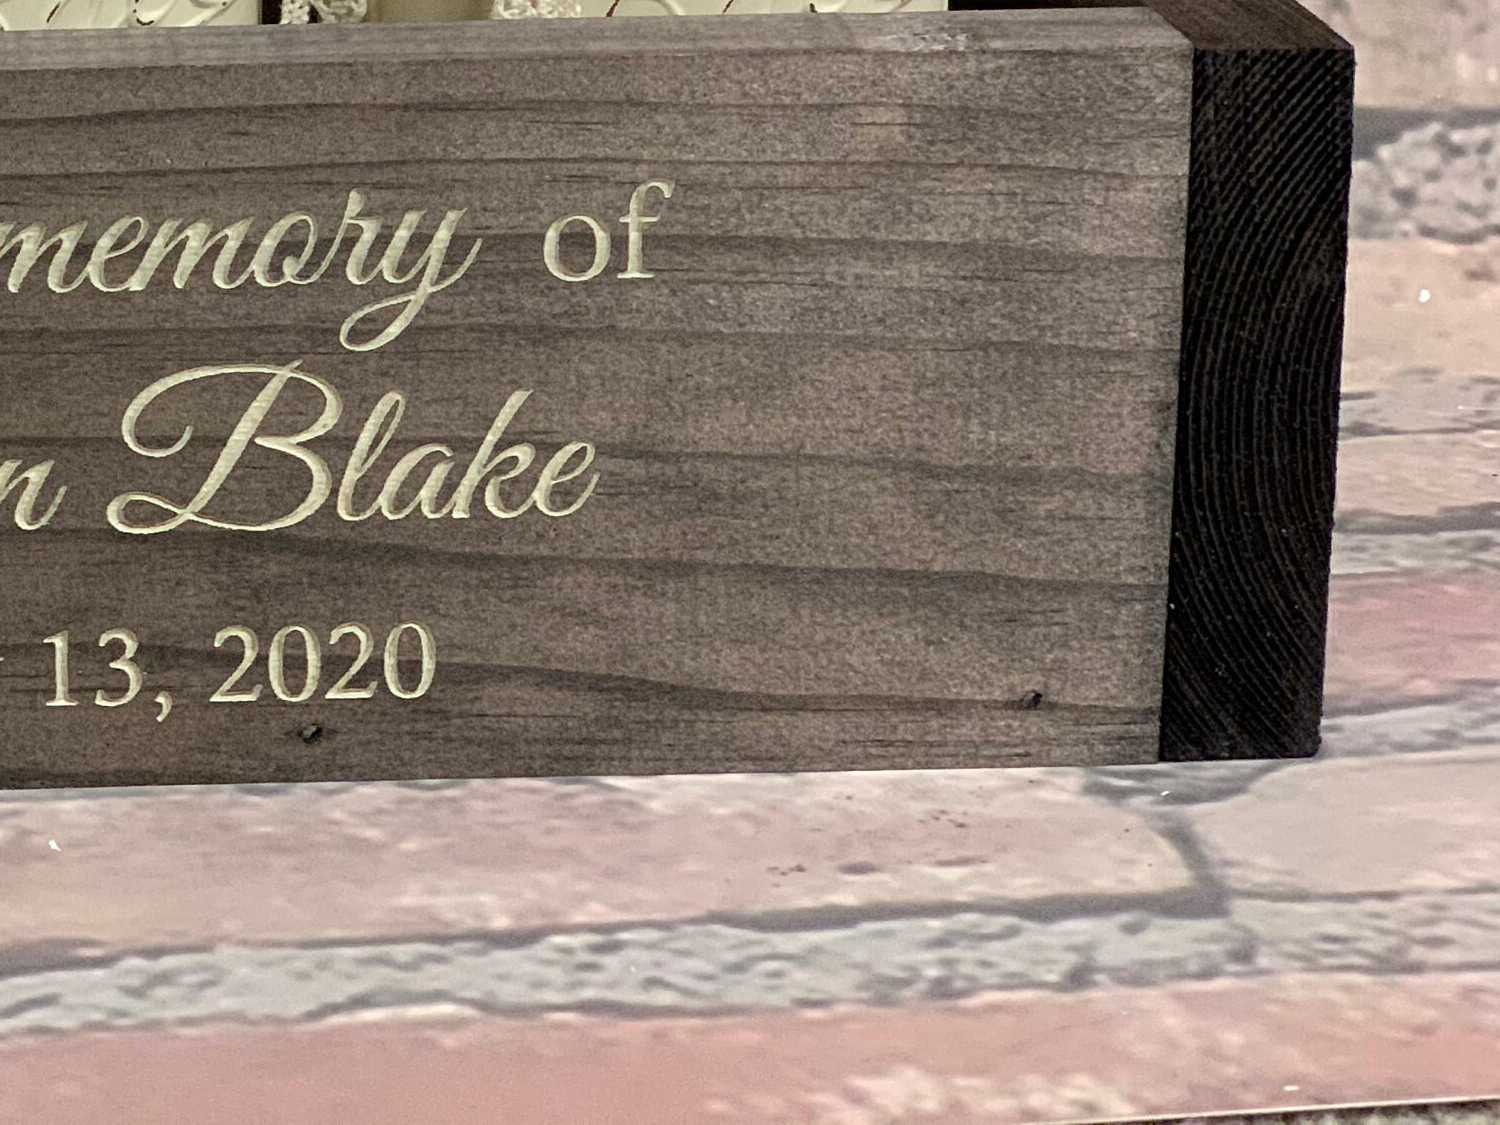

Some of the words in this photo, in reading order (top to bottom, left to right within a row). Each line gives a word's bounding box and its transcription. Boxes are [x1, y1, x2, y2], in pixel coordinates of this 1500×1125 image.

[542, 180, 673, 282] of
[105, 360, 601, 536] Blake
[41, 631, 174, 723] 13,
[208, 622, 437, 704] 2020
